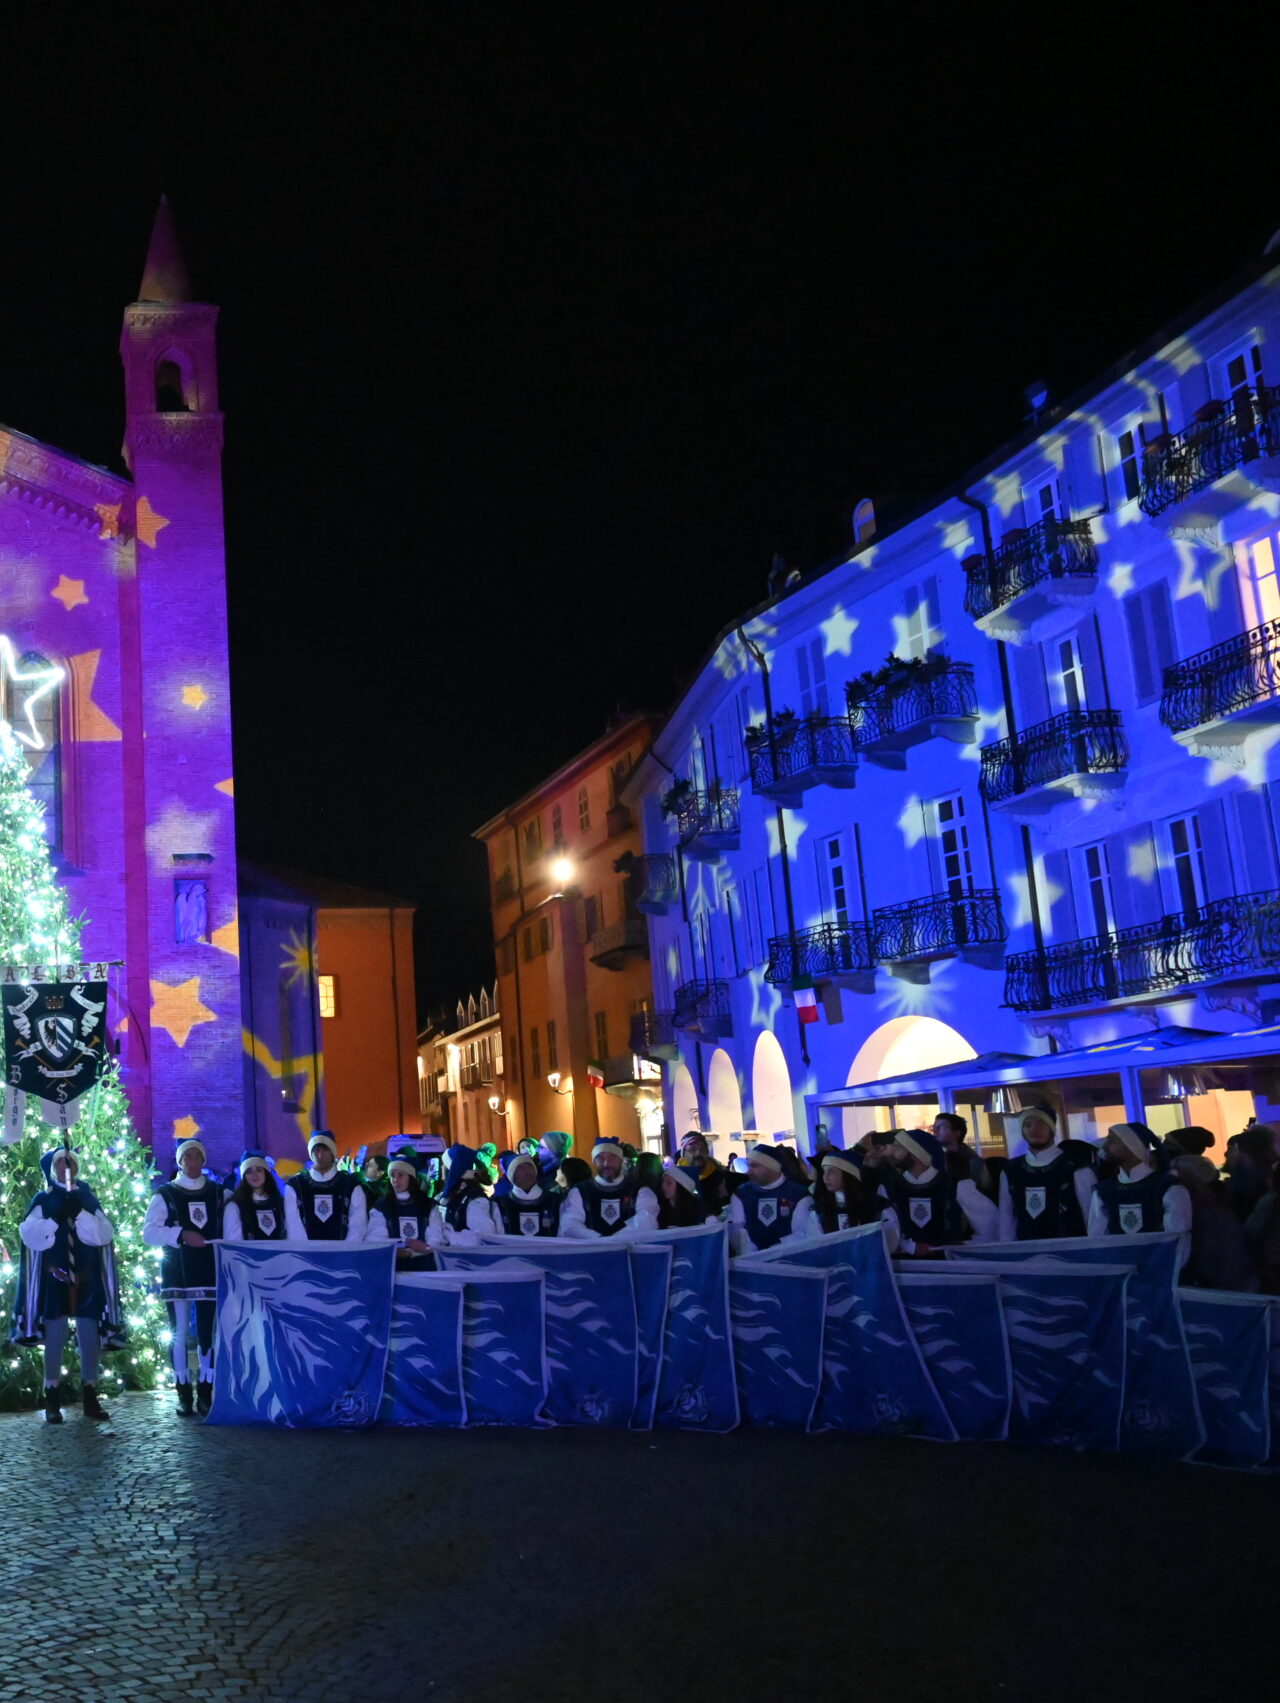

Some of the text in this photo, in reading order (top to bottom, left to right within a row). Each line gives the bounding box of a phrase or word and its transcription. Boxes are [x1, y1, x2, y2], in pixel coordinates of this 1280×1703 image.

[4, 963, 107, 982] ALBA
[9, 1065, 22, 1126] Borgo
[56, 1083, 68, 1126] San
